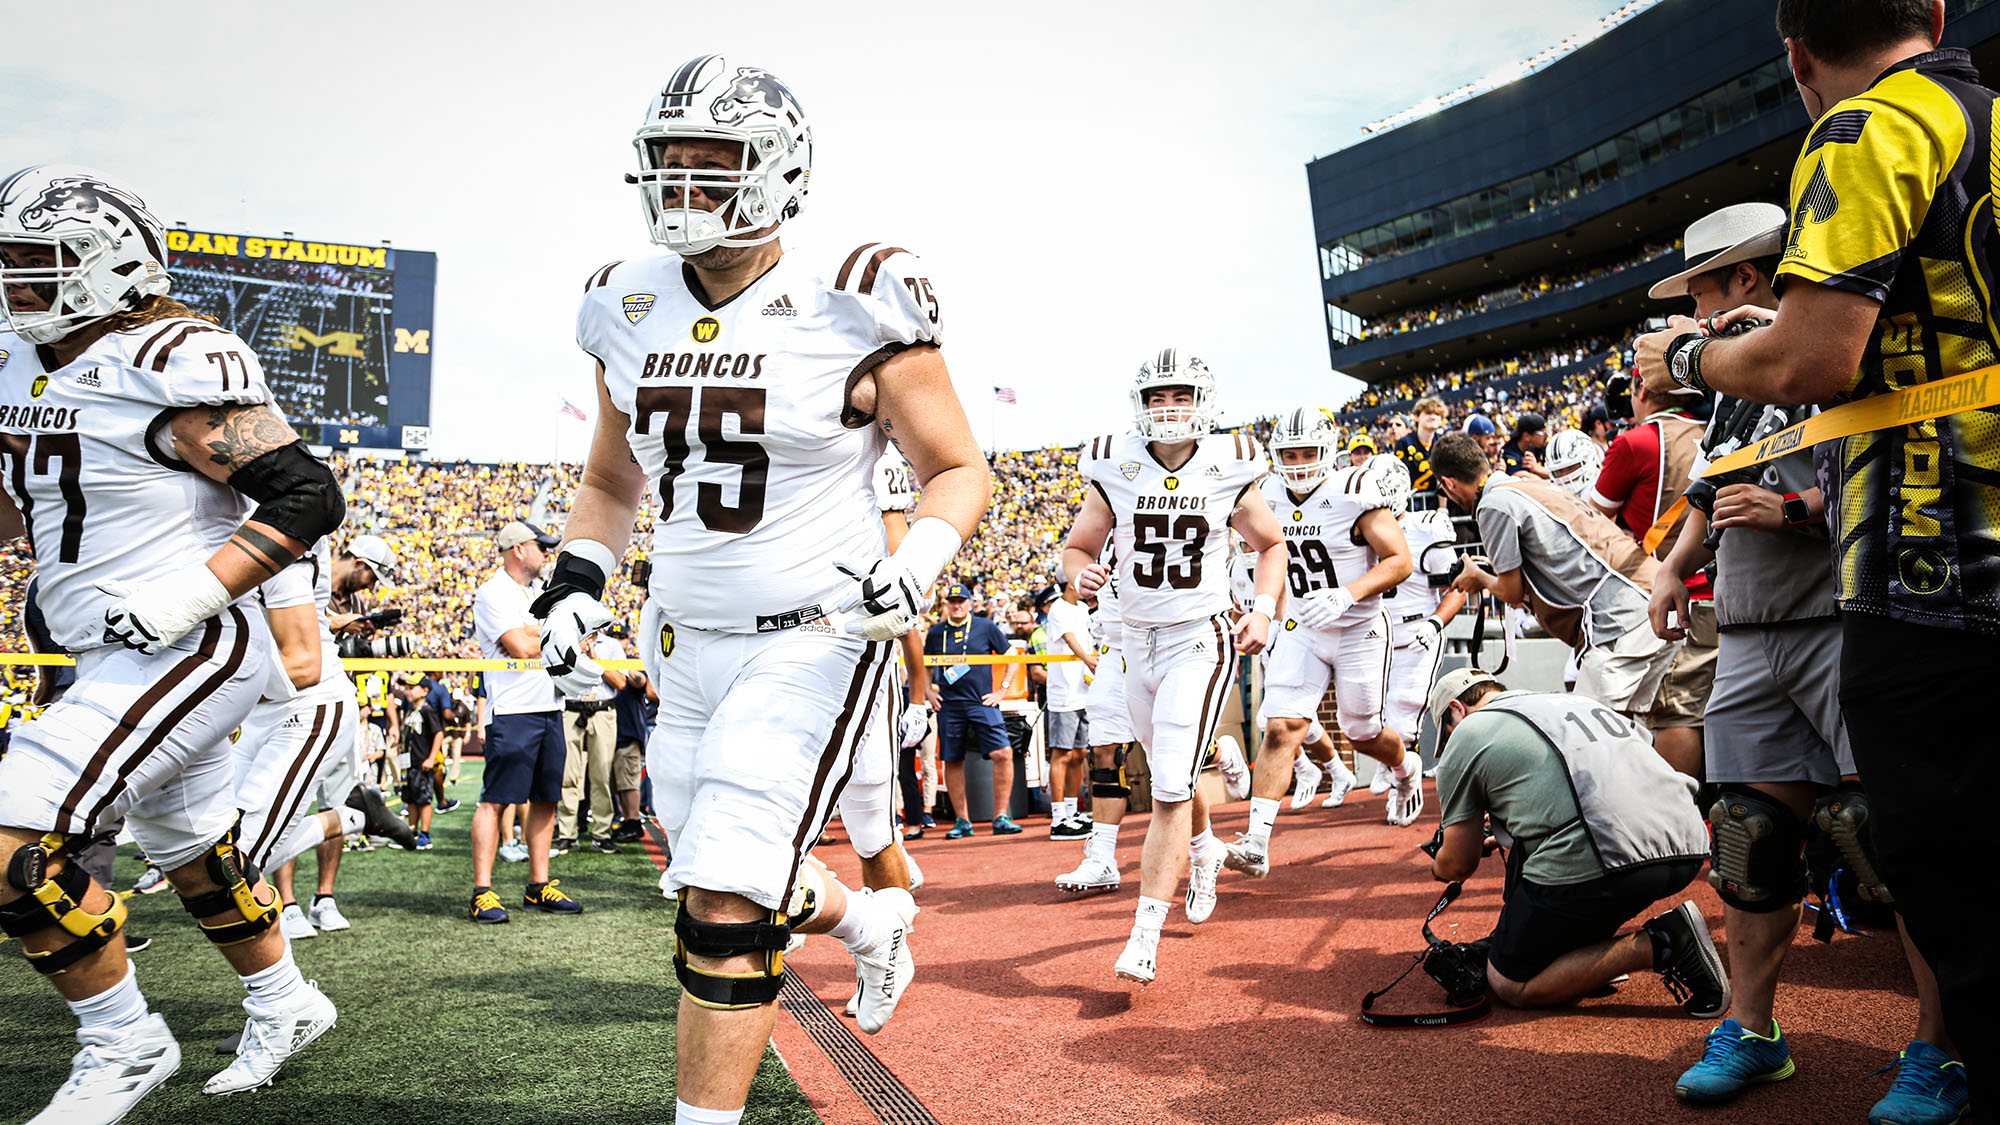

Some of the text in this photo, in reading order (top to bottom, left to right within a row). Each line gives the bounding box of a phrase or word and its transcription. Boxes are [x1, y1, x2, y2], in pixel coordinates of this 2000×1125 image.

[658, 109, 685, 119] FOUR
[244, 238, 386, 268] STADIUM
[623, 302, 653, 312] MAC
[761, 306, 798, 317] adidas
[903, 277, 939, 325] 75
[393, 328, 430, 355] M
[695, 322, 717, 340] W
[205, 351, 249, 392] 77
[640, 352, 768, 379] BRONCOS
[76, 376, 103, 388] adidas
[0, 405, 81, 430] BRONCOS
[339, 428, 359, 445] M
[634, 386, 770, 534] 75
[1755, 440, 1771, 461] M
[884, 467, 908, 495] 22
[1165, 478, 1178, 490] W
[0, 432, 87, 564] 77
[1136, 496, 1207, 510] BRONCOS
[1282, 525, 1322, 537] RONCOS
[1133, 513, 1210, 590] 53
[1285, 539, 1340, 599] 69
[783, 619, 797, 629] 2XL
[799, 624, 837, 635] adidas
[662, 630, 673, 653] W
[506, 661, 518, 670] M
[1564, 707, 1632, 743] 10
[1414, 1016, 1448, 1025] Canon
[290, 1019, 324, 1052] adidas
